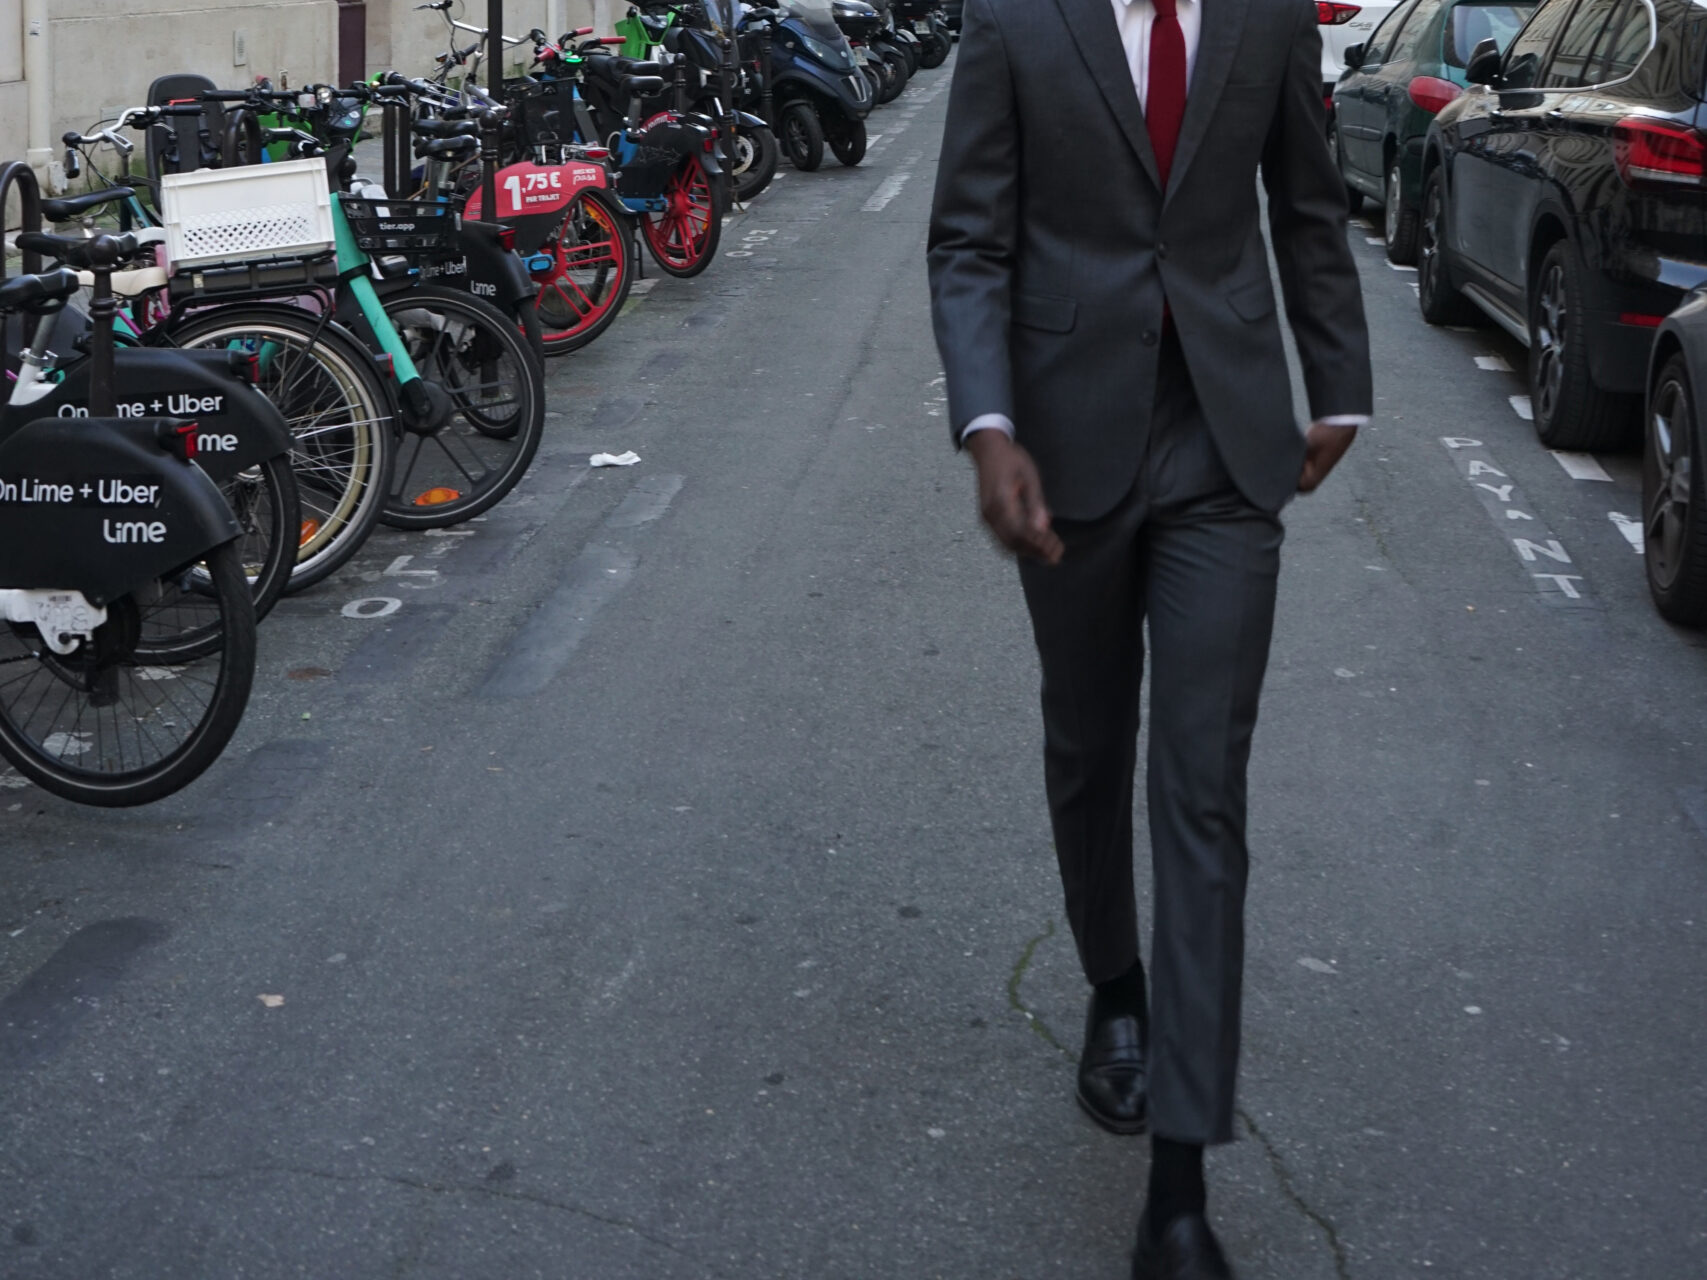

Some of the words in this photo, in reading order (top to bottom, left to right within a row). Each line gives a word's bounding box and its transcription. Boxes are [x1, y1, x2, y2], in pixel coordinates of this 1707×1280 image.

[379, 222, 415, 231] tier.app
[470, 280, 496, 296] Lime
[167, 394, 223, 415] Uber
[197, 433, 238, 452] me
[21, 478, 75, 503] Lime
[98, 479, 160, 504] Uber
[103, 518, 167, 544] Lime
